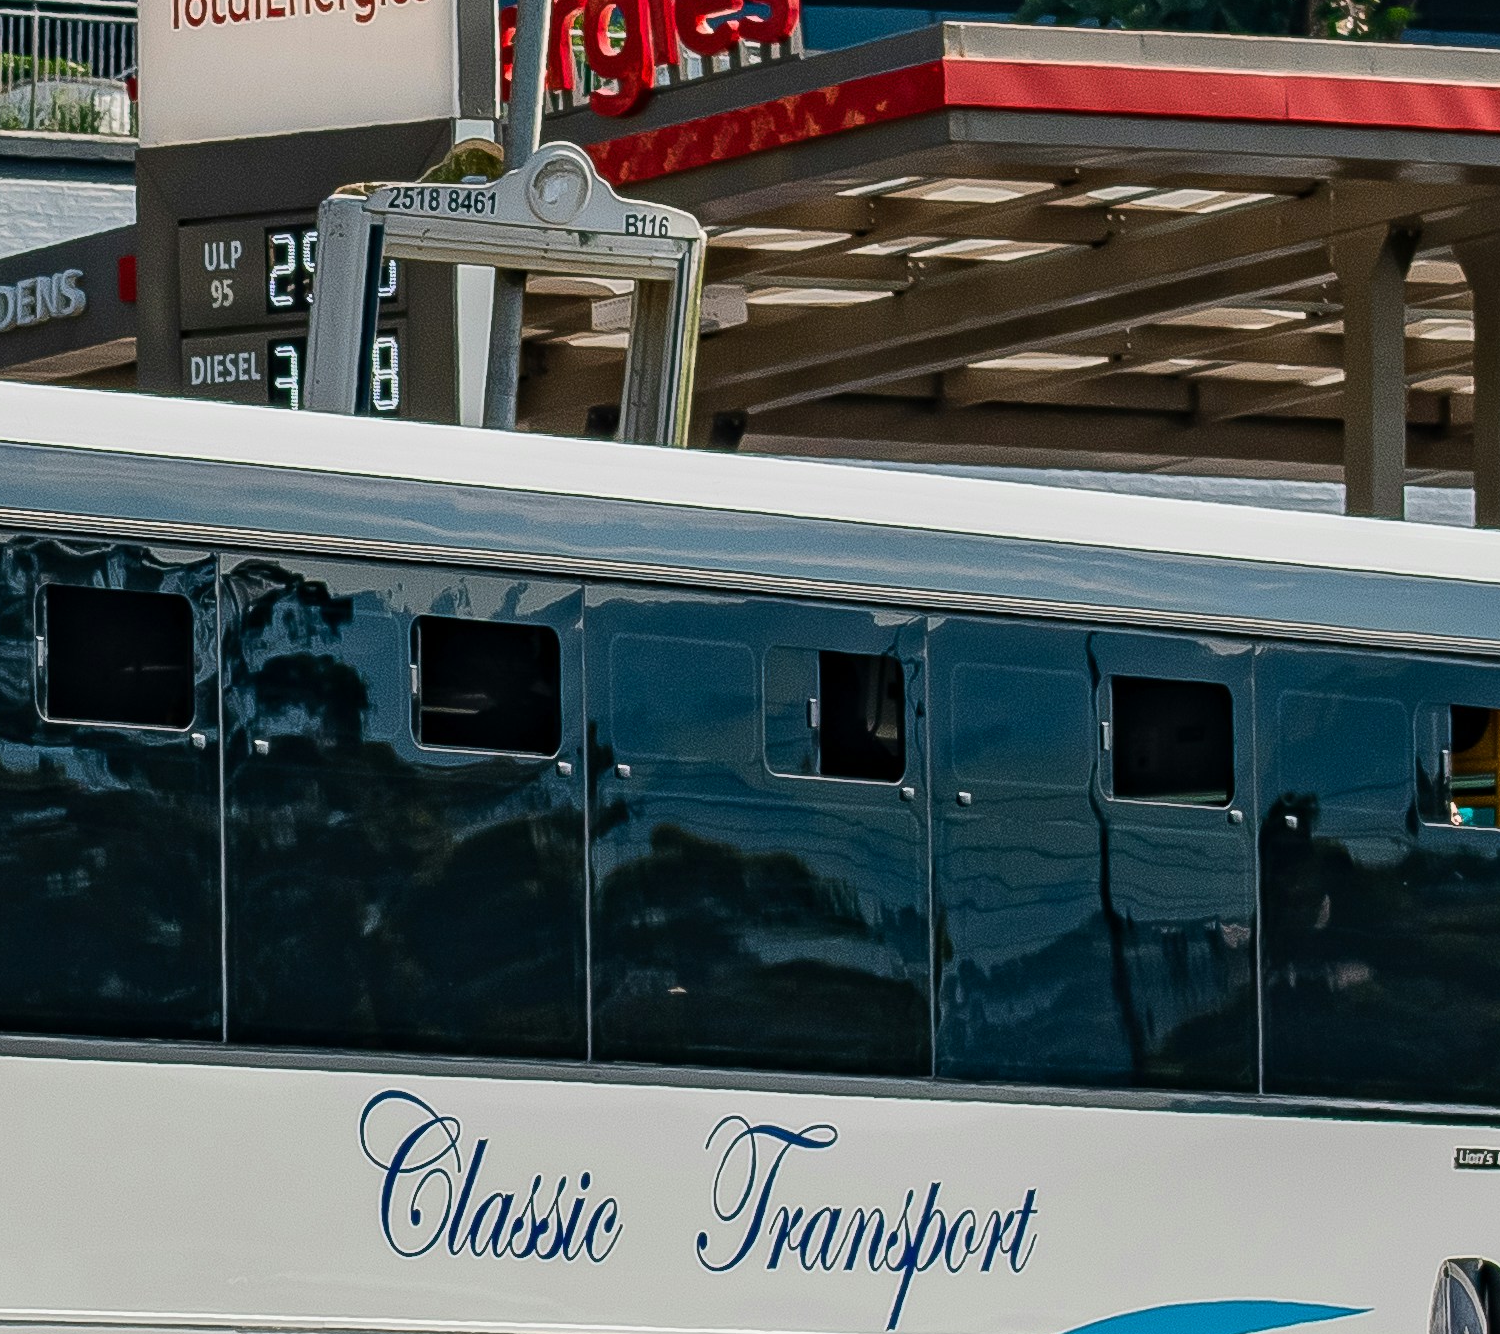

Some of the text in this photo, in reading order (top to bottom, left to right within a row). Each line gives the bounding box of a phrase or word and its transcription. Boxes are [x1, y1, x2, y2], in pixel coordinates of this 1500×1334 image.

[388, 186, 498, 215] 2518 8461
[625, 213, 669, 237] B116
[204, 240, 243, 271] ULP
[210, 279, 235, 309] 95
[190, 352, 261, 386] DIESEL
[1459, 1150, 1494, 1165] Lion's
[360, 1089, 1039, 1332] Classic Transport
